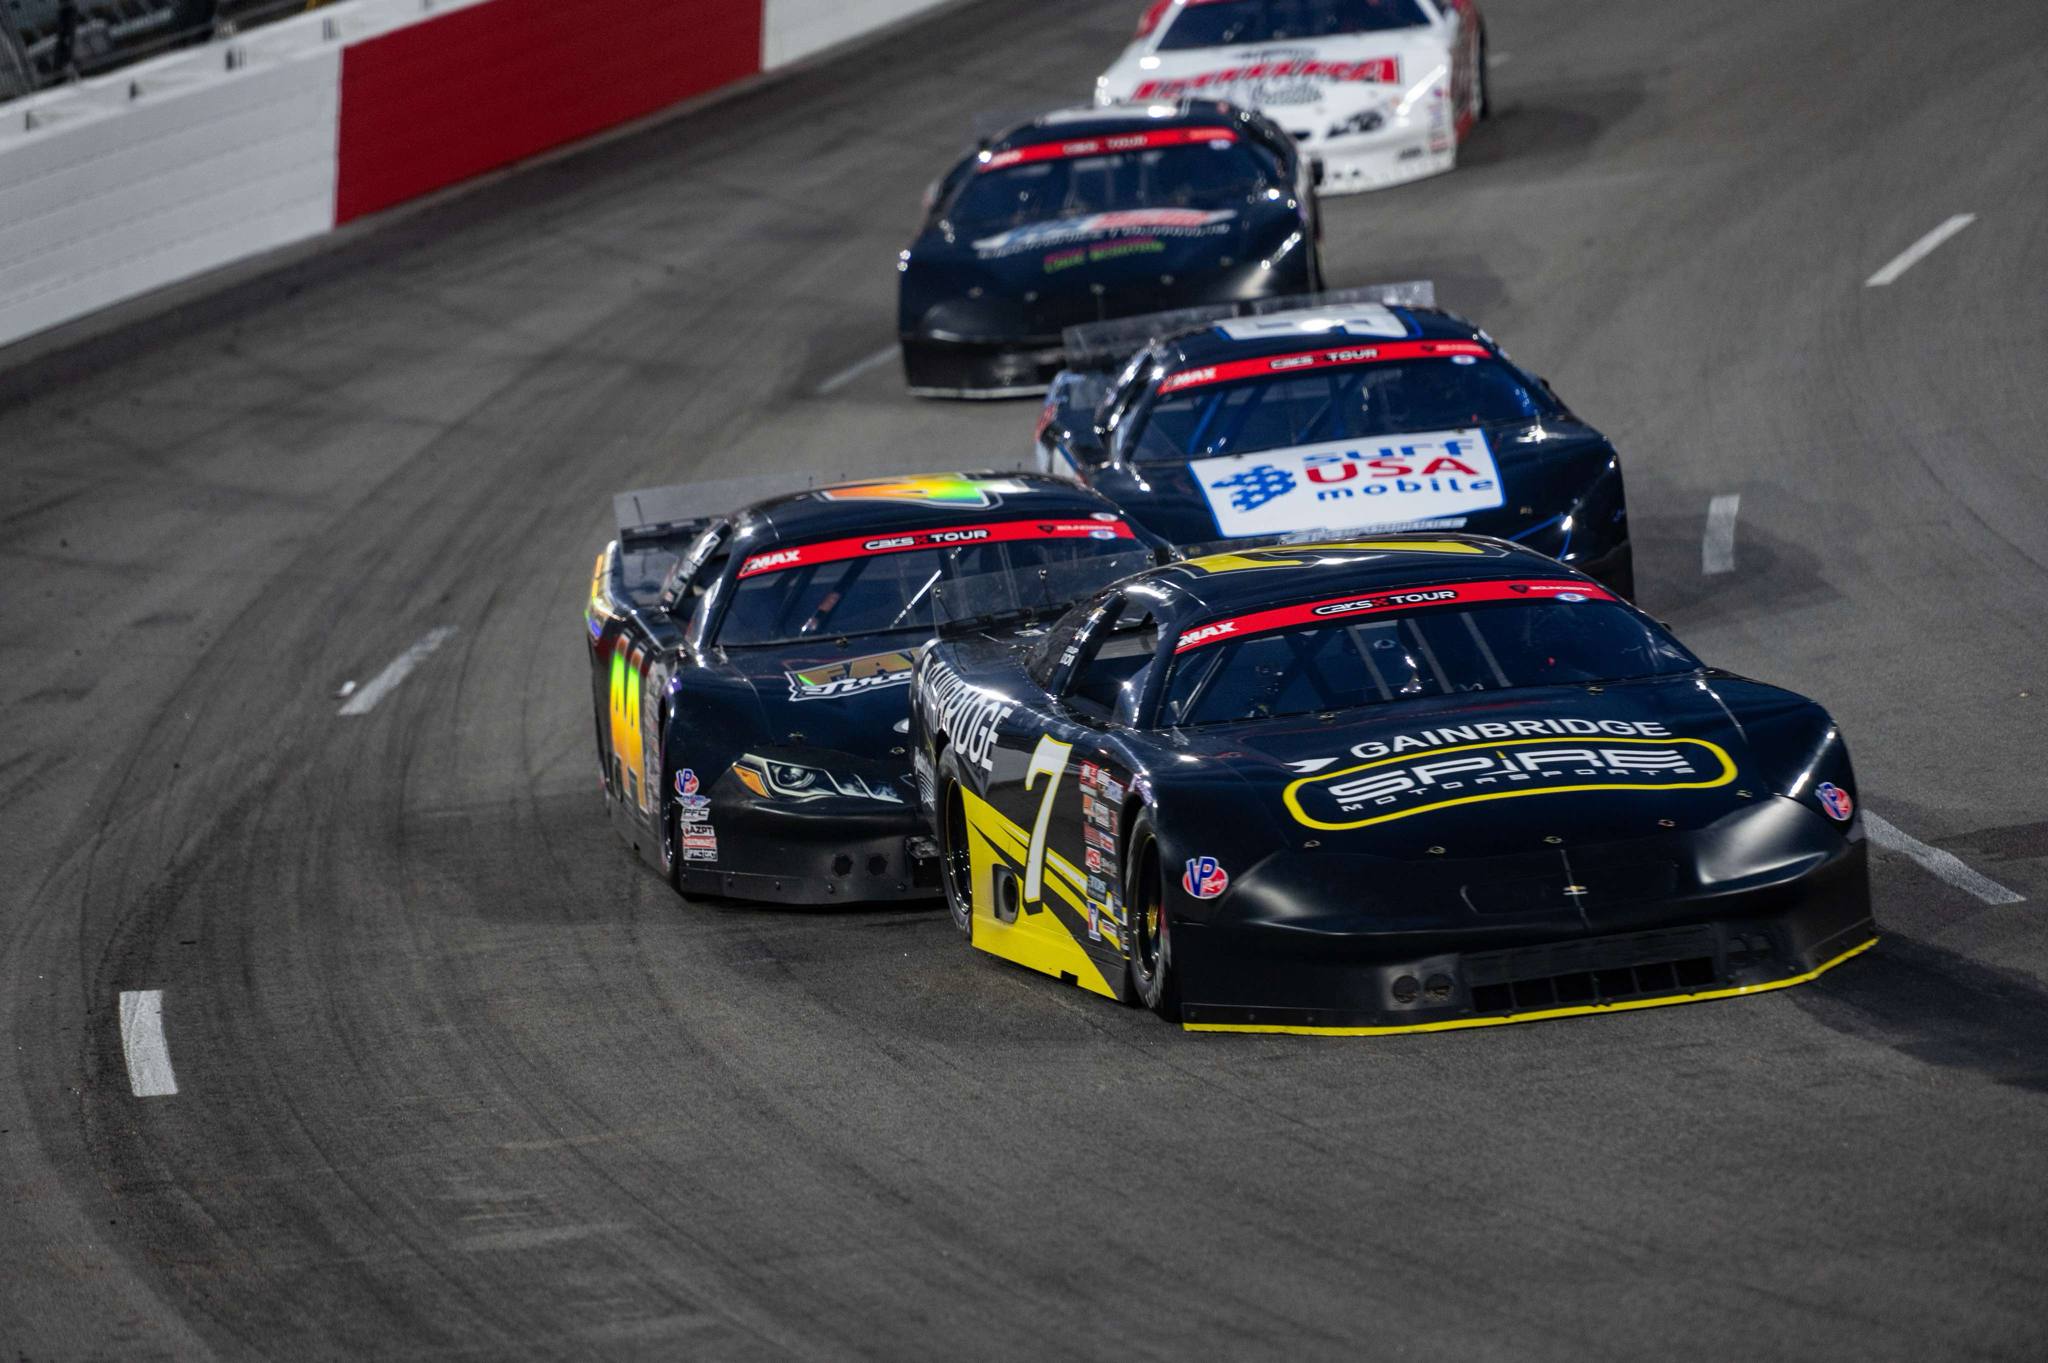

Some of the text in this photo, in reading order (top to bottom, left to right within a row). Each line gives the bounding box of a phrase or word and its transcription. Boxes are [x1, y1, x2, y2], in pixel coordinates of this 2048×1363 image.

[1305, 457, 1479, 483] USA
[1317, 478, 1493, 501] mobile
[930, 529, 988, 543] TOUR
[1389, 590, 1456, 604] TOUR
[1350, 718, 1673, 759] GAINBRIDGE
[1341, 766, 1697, 812] MOTORSPORTS
[1024, 734, 1073, 903] 7
